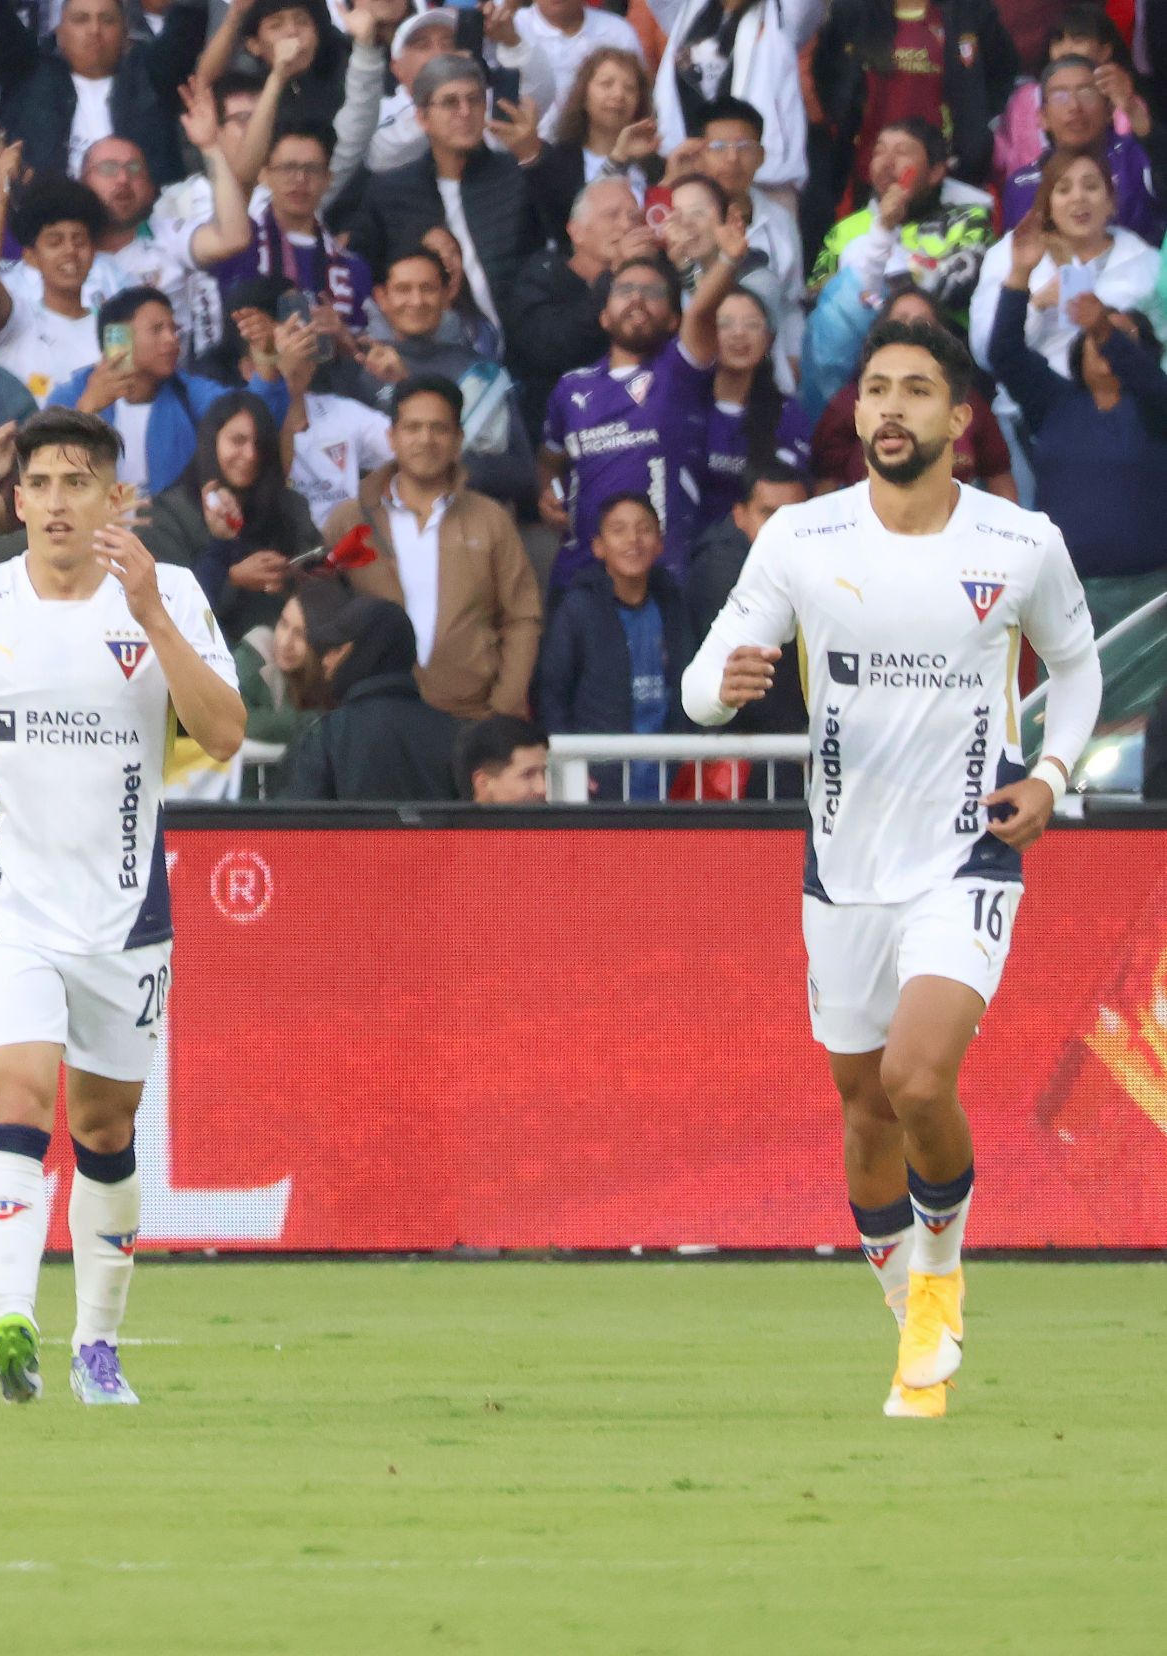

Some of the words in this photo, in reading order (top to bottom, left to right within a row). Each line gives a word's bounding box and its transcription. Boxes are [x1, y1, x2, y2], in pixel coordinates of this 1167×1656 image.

[870, 653, 947, 669] BANCO
[869, 671, 984, 688] PICHINCHA
[25, 710, 102, 727] BANCO
[25, 729, 141, 745] PICHINCHA
[954, 705, 990, 834] Ecuabet
[118, 760, 142, 891] Ecuabet
[967, 887, 1004, 941] 16
[136, 965, 168, 1028] 20
